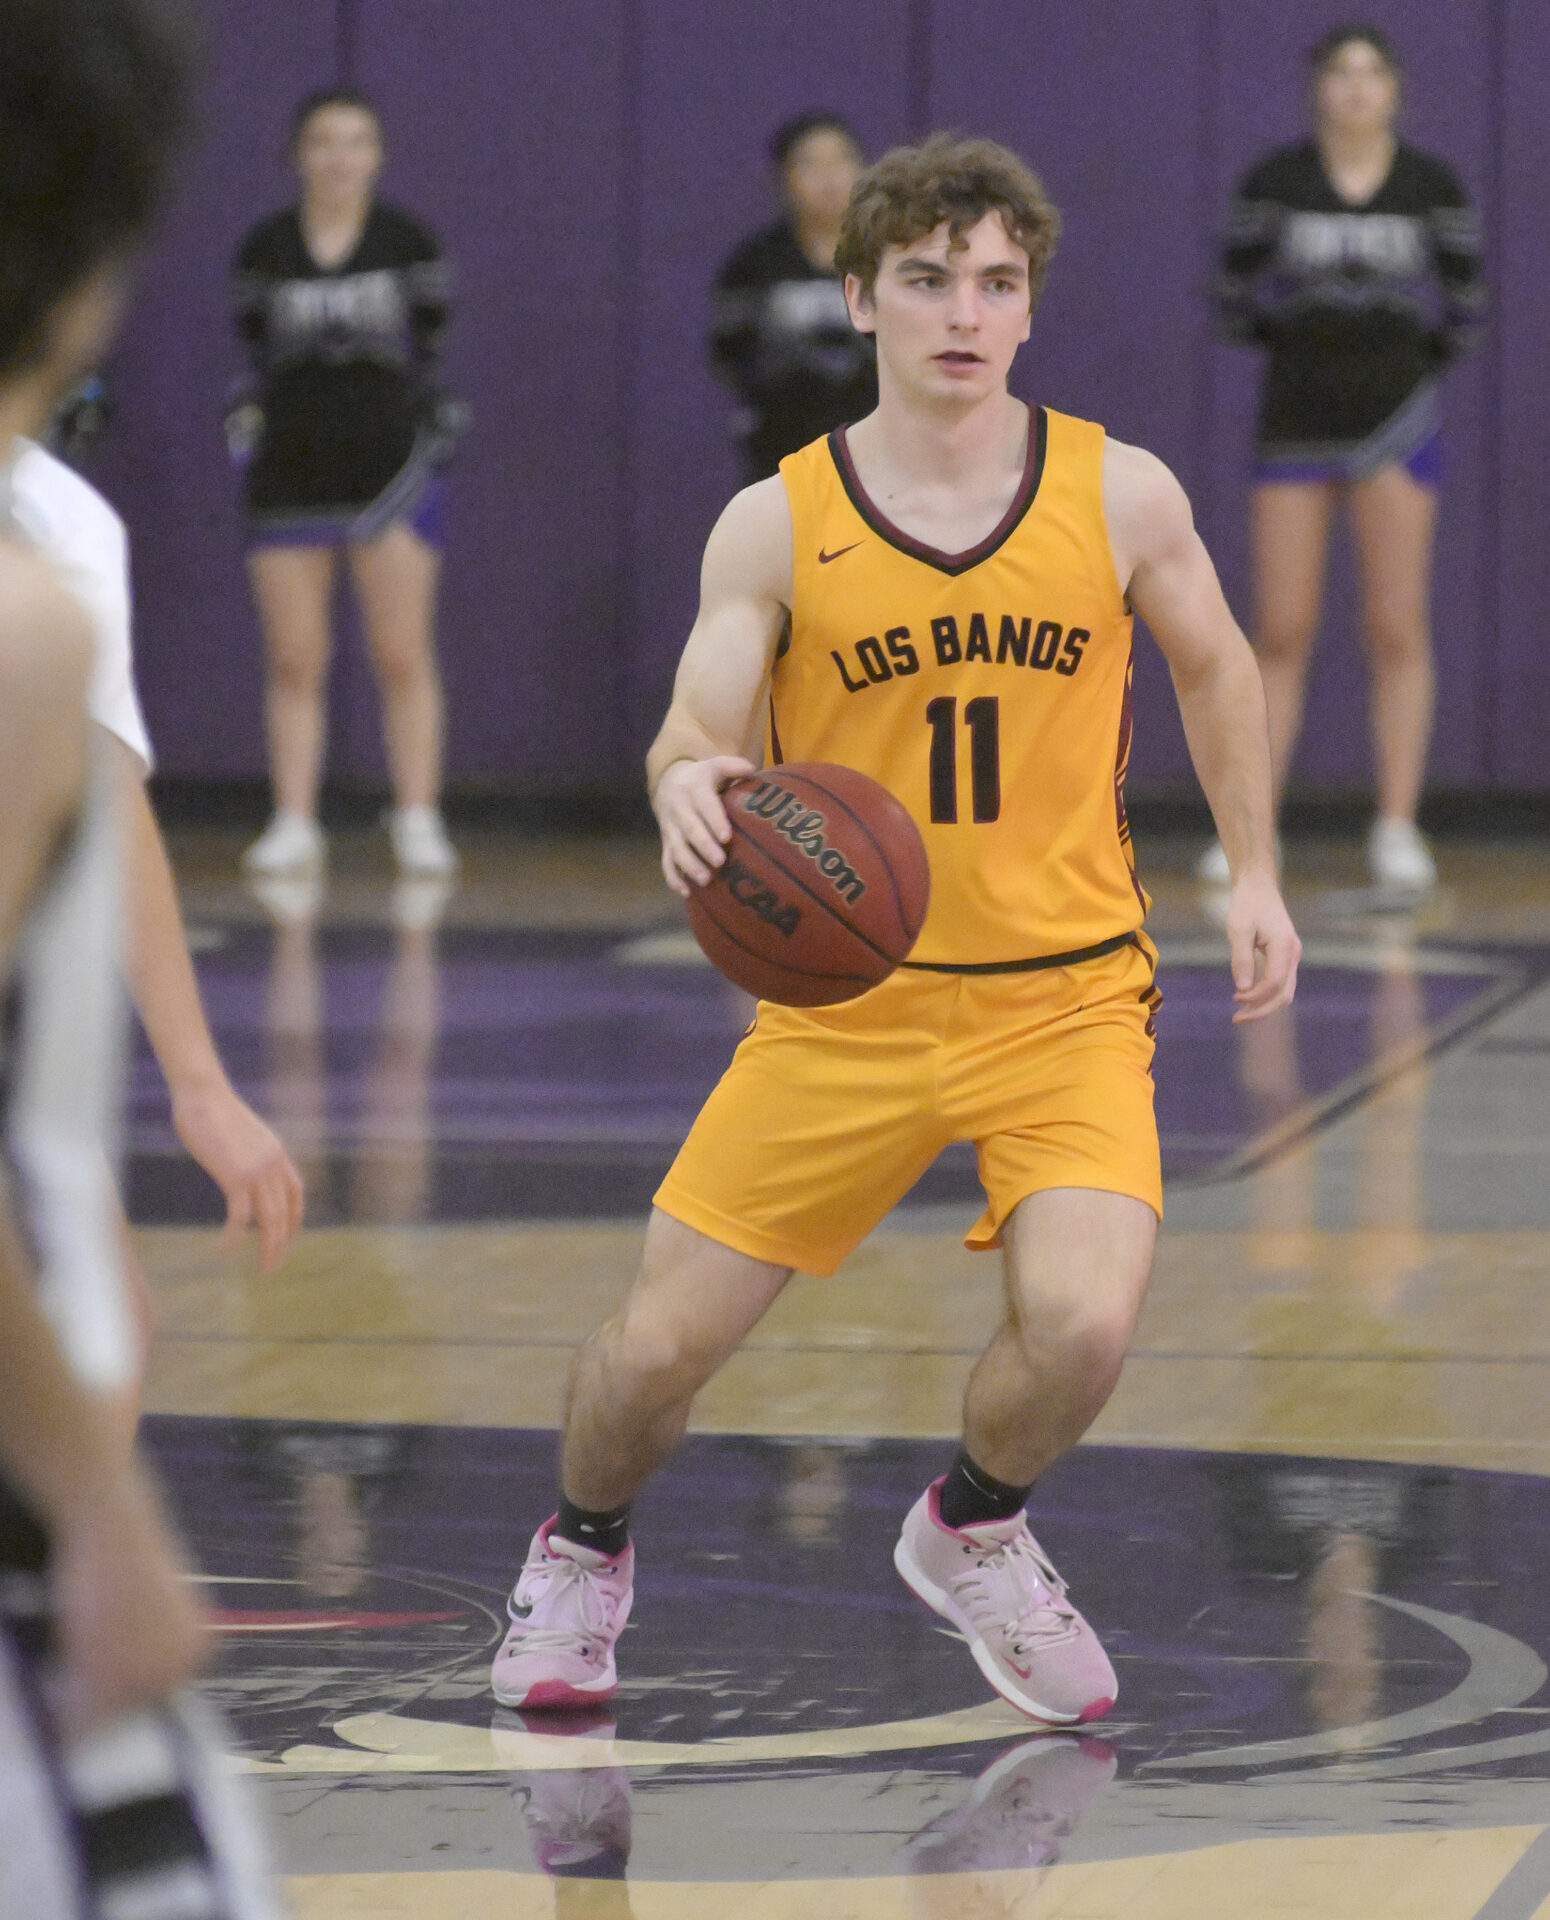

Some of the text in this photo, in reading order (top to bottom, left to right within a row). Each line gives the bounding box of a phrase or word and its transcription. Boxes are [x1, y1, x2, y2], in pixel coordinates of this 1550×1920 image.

[830, 612, 1091, 693] LOS BANOS
[926, 696, 1001, 824] 11
[745, 781, 866, 907] Wilson
